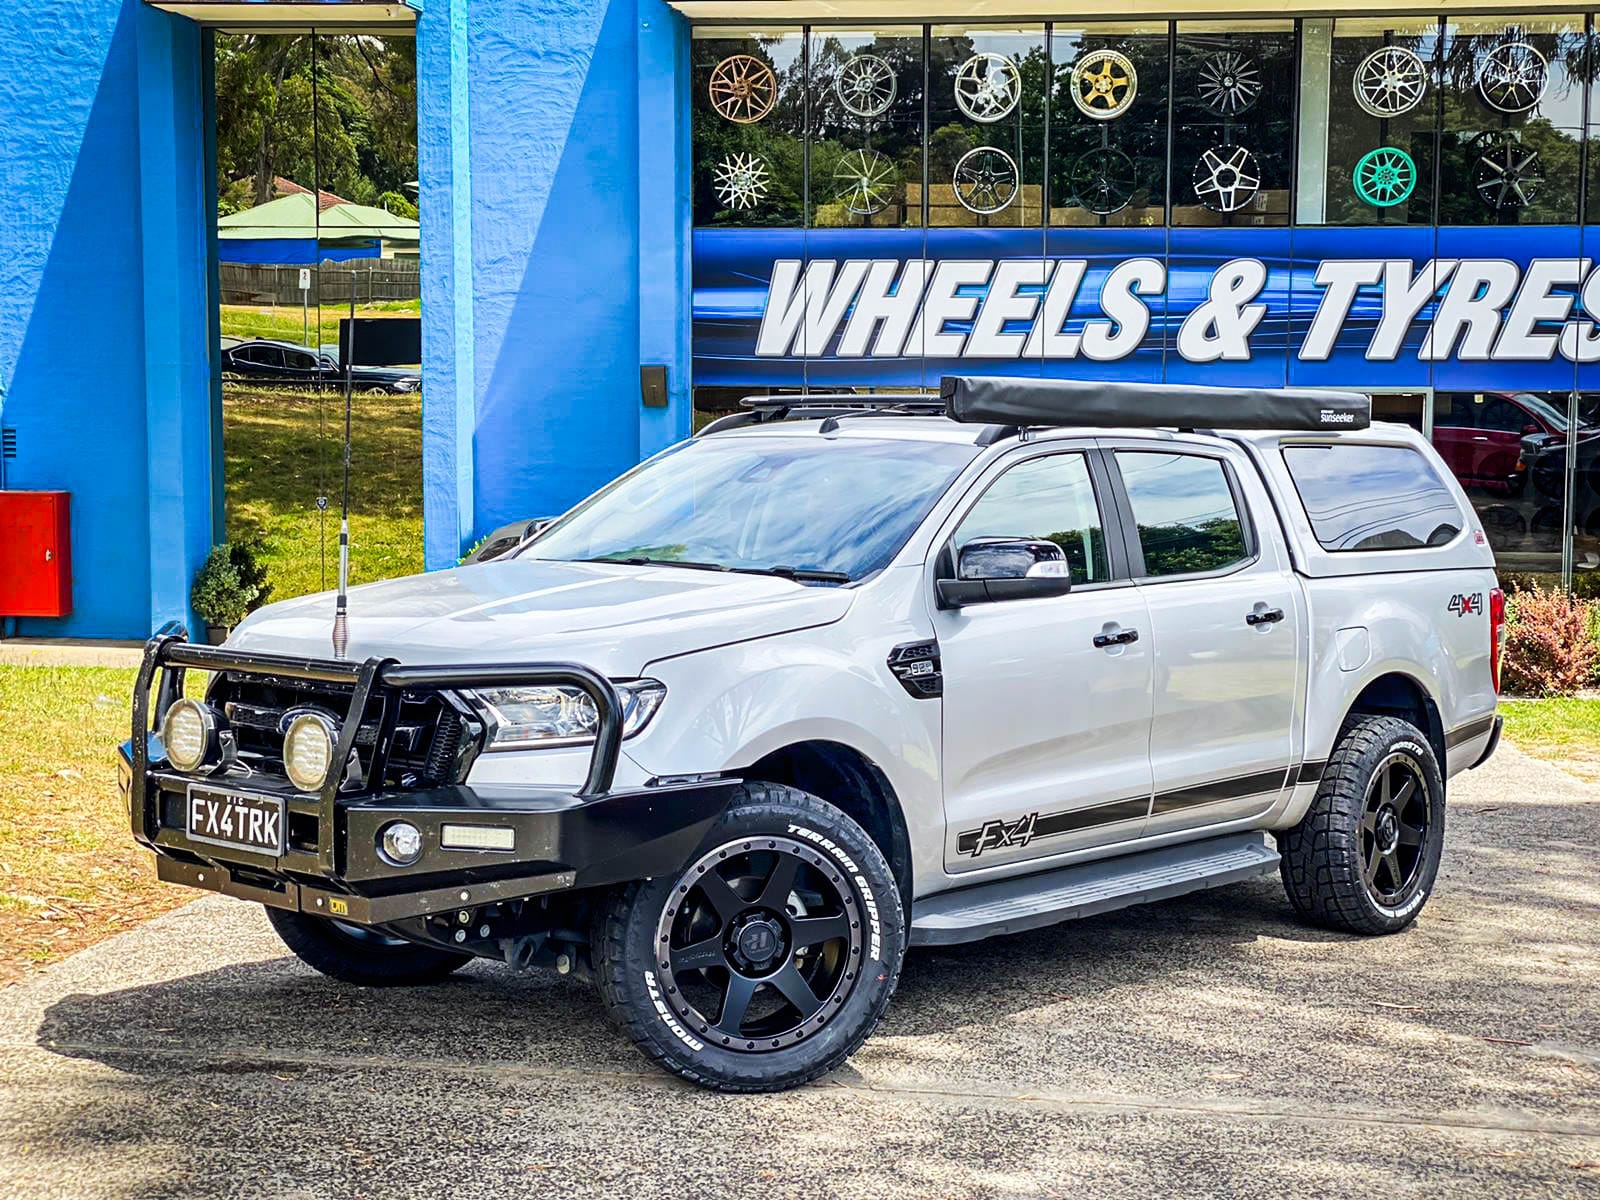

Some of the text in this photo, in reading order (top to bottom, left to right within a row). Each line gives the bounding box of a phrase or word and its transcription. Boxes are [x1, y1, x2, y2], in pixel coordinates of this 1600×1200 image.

[755, 257, 1167, 361] WHEELS
[1177, 257, 1267, 362] &
[191, 798, 279, 846] FX4TRK
[787, 824, 881, 961] TERRAIN GRIPPER
